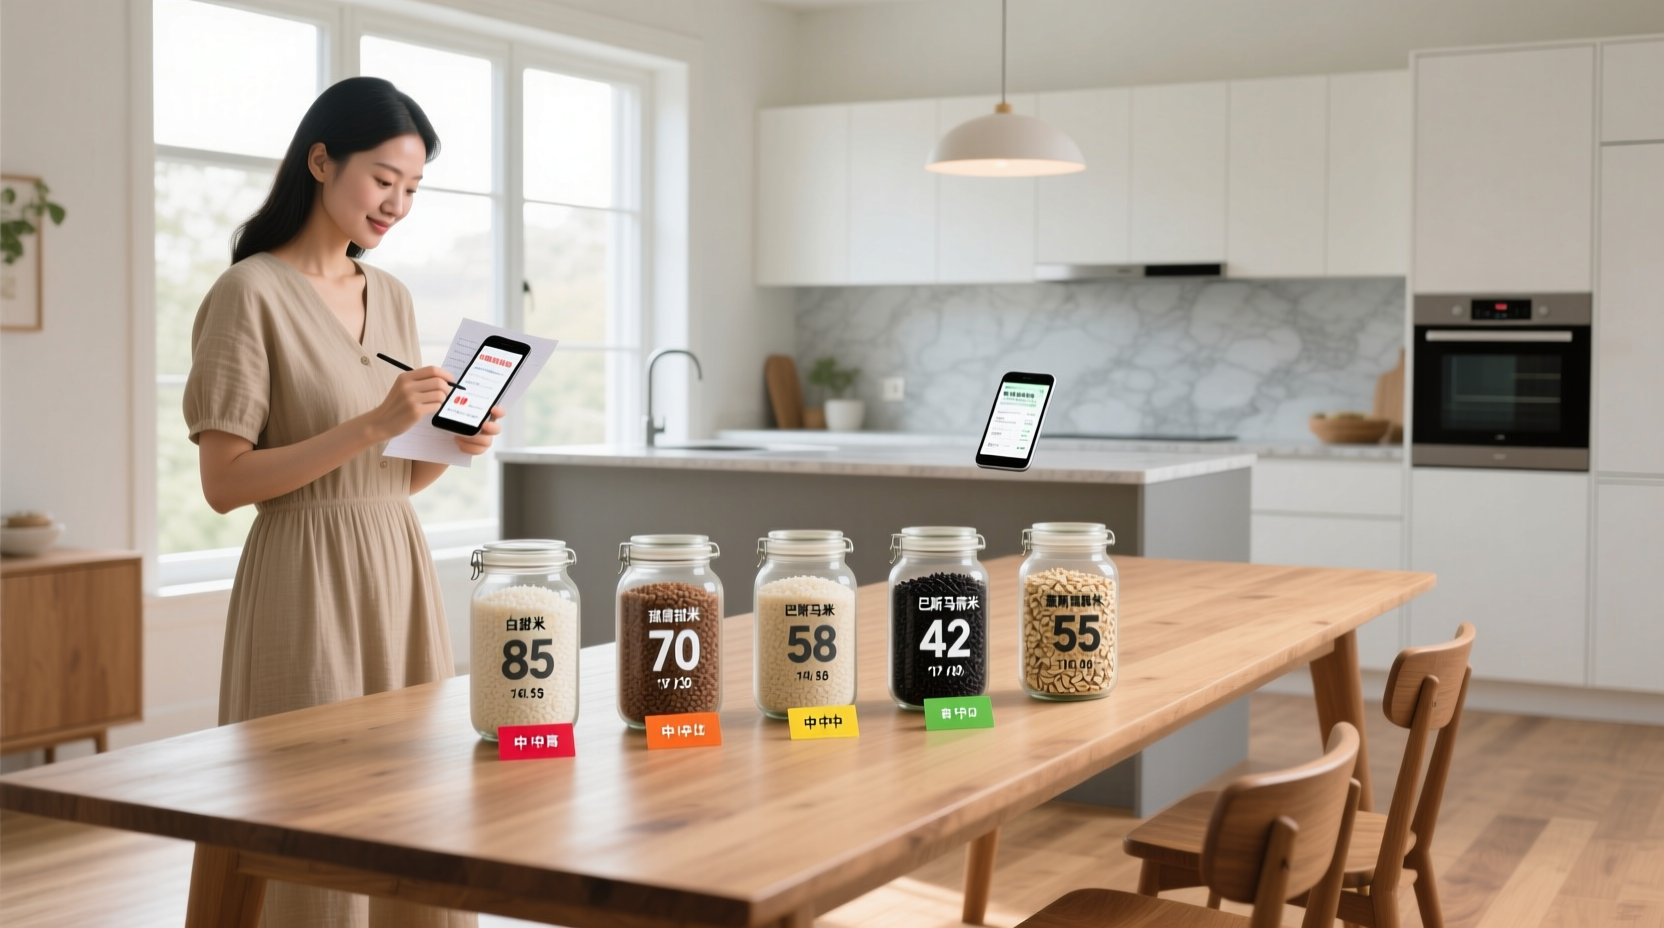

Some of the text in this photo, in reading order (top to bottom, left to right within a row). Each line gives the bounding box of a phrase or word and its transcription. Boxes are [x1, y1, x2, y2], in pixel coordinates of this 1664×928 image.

[649, 629, 700, 672] 70
[787, 624, 837, 664] 58
[919, 618, 971, 658] 42
[1053, 615, 1101, 652] 55
[501, 638, 555, 680] 85
